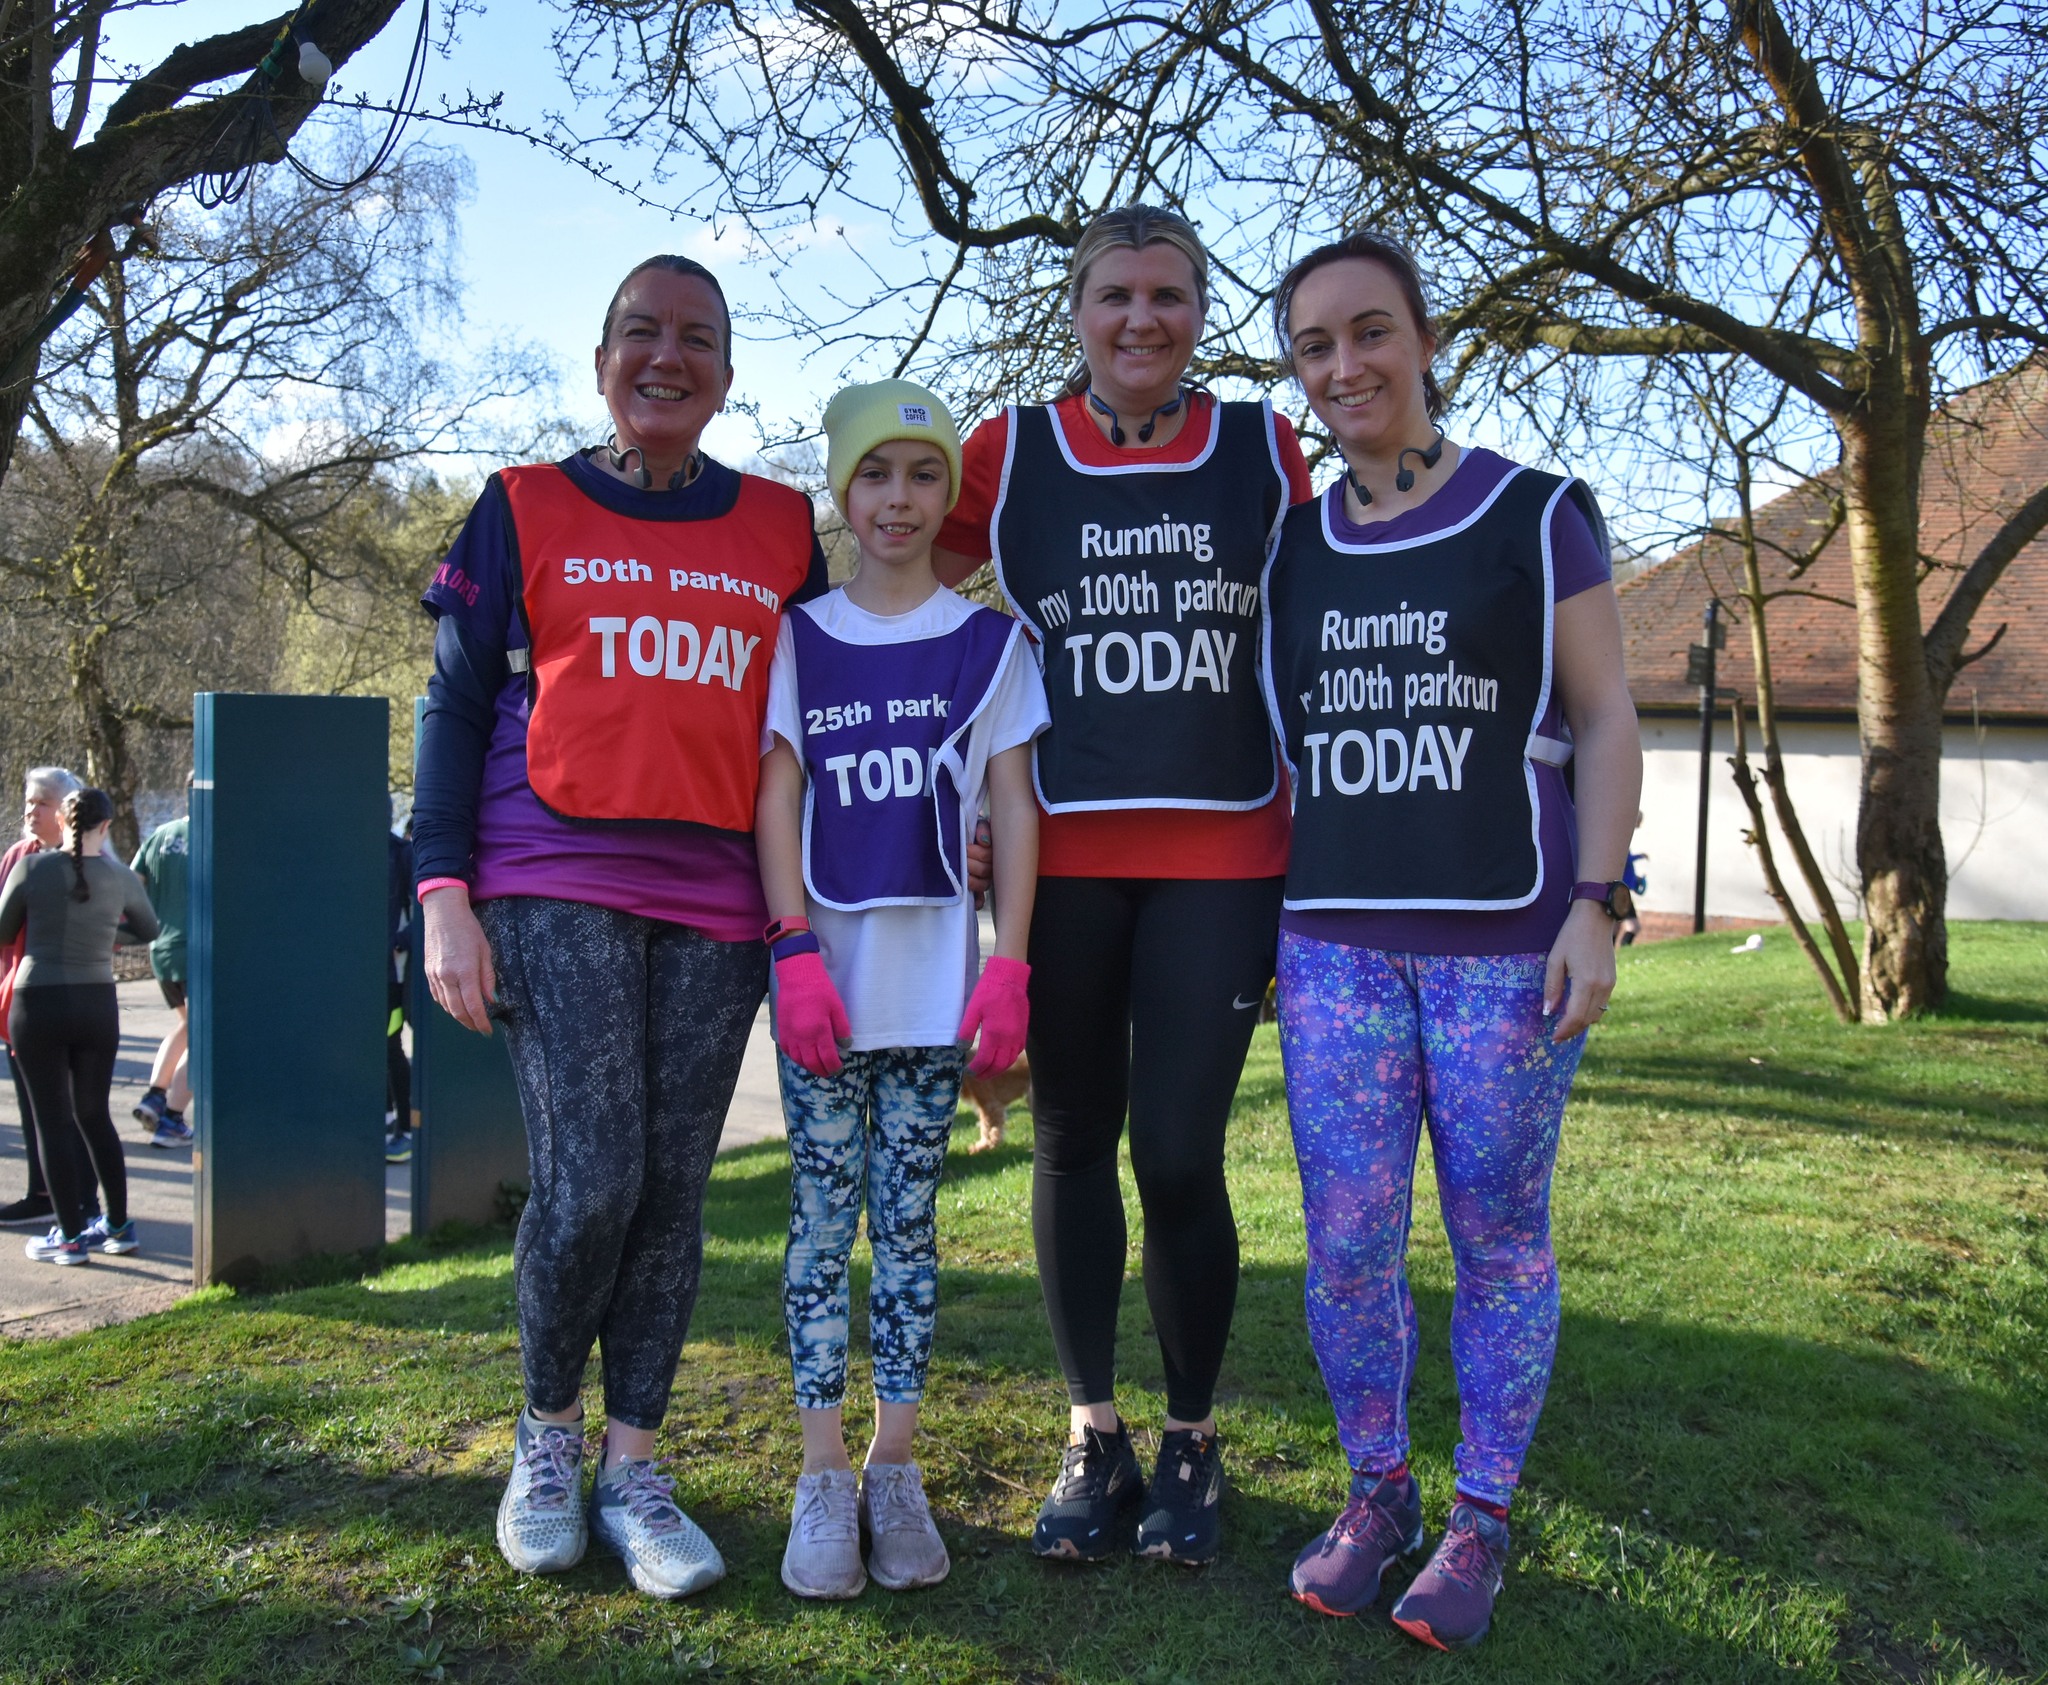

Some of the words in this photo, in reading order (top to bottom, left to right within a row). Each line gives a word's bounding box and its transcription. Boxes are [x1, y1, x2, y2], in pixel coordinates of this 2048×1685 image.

[1081, 513, 1214, 562] Running
[563, 558, 653, 585] 50th
[669, 569, 780, 614] parkrun
[1037, 589, 1071, 632] my
[1080, 570, 1159, 616] 100th
[1174, 567, 1259, 623] parkrun
[589, 615, 761, 692] TODAY
[1321, 601, 1448, 655] Running
[1065, 629, 1237, 697] TODAY
[1319, 663, 1393, 714] 100th
[1404, 660, 1498, 719] parkrun
[805, 701, 872, 735] 25th
[886, 693, 952, 724] park
[1303, 725, 1474, 797] TODAY
